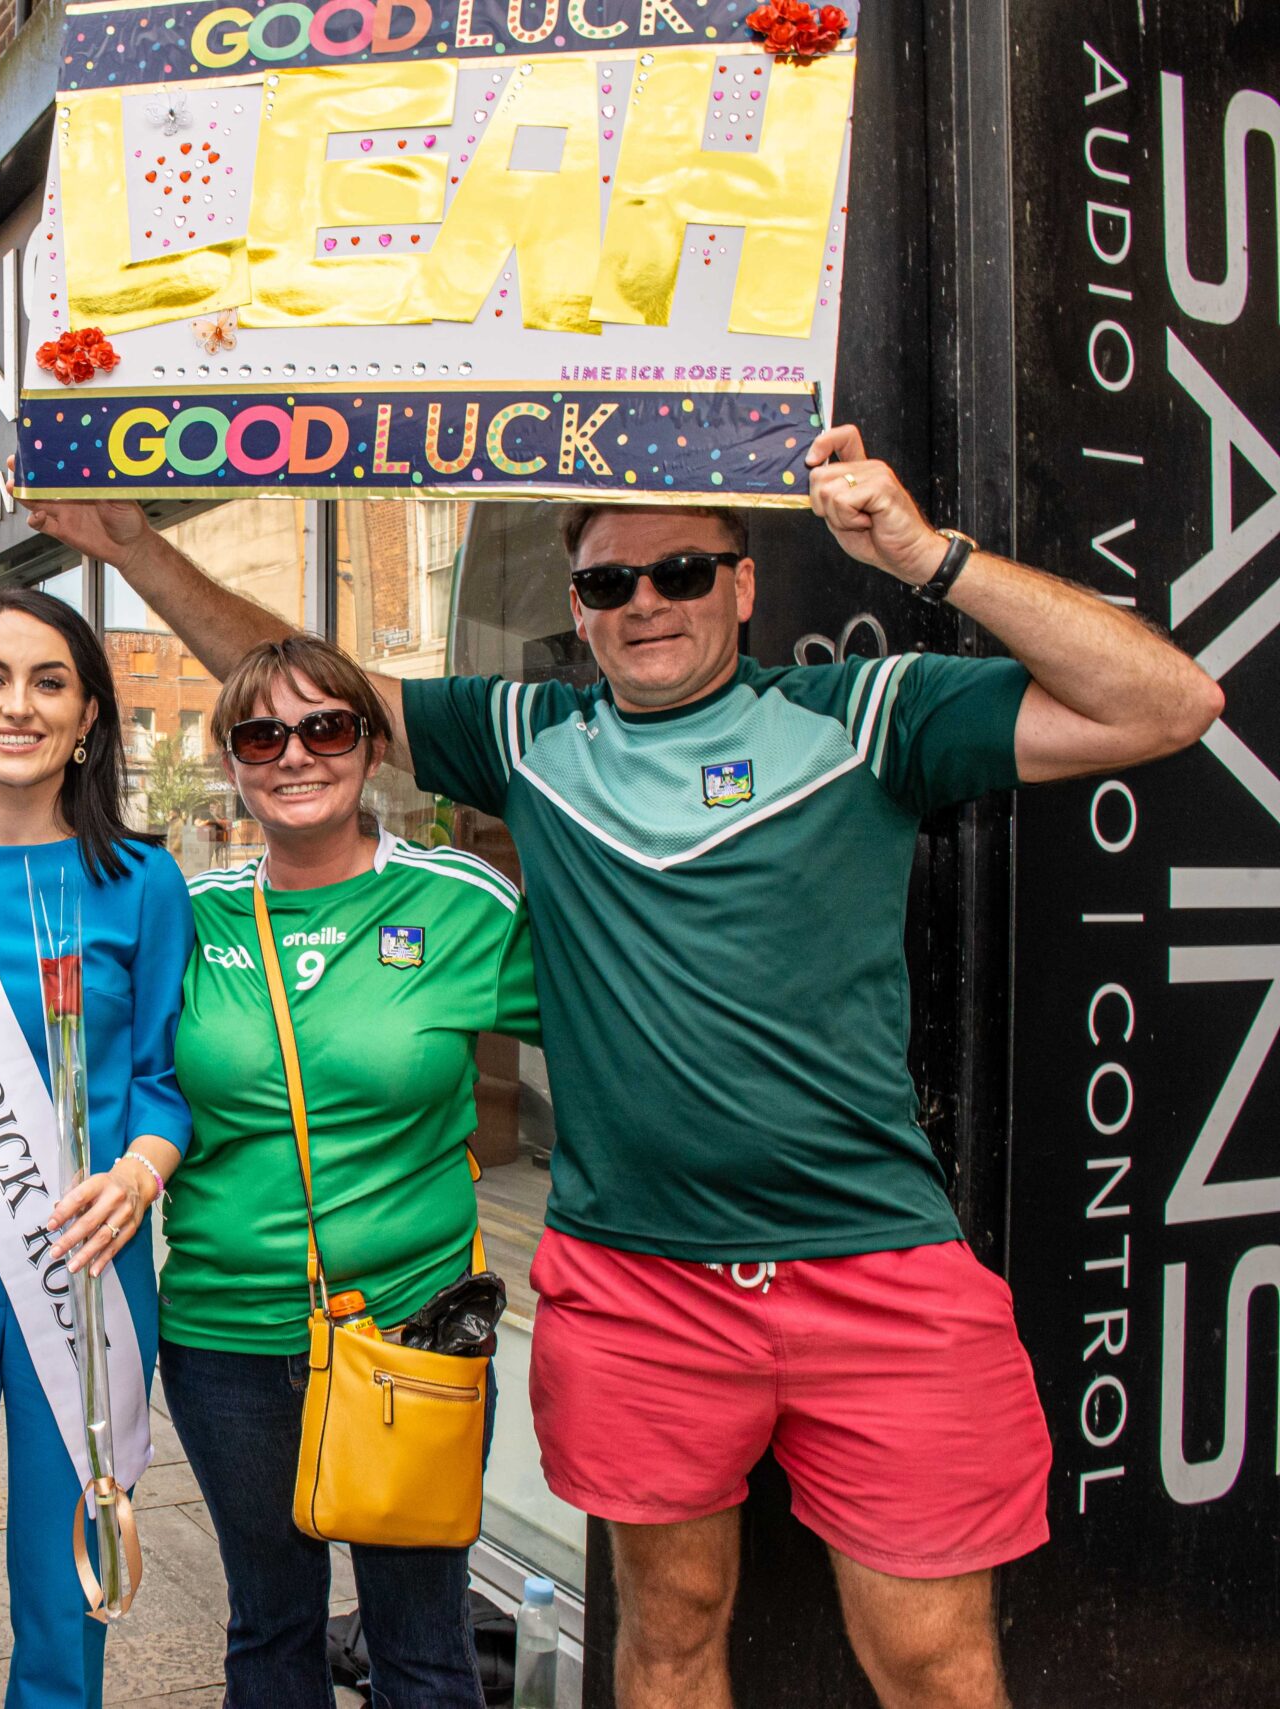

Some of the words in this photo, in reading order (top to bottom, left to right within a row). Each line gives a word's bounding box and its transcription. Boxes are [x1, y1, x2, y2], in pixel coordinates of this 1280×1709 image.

[191, 0, 432, 68] GOOD
[455, 0, 694, 47] LUCK
[56, 50, 857, 338] LEAH
[1082, 40, 1135, 393] AUDIO
[561, 365, 665, 381] LIMERICK
[674, 365, 732, 381] ROSE
[742, 366, 805, 382] 2025
[108, 405, 349, 477] GOOD
[373, 402, 619, 476] LUCK
[295, 950, 326, 991] 9
[1078, 982, 1137, 1516] CONTROL
